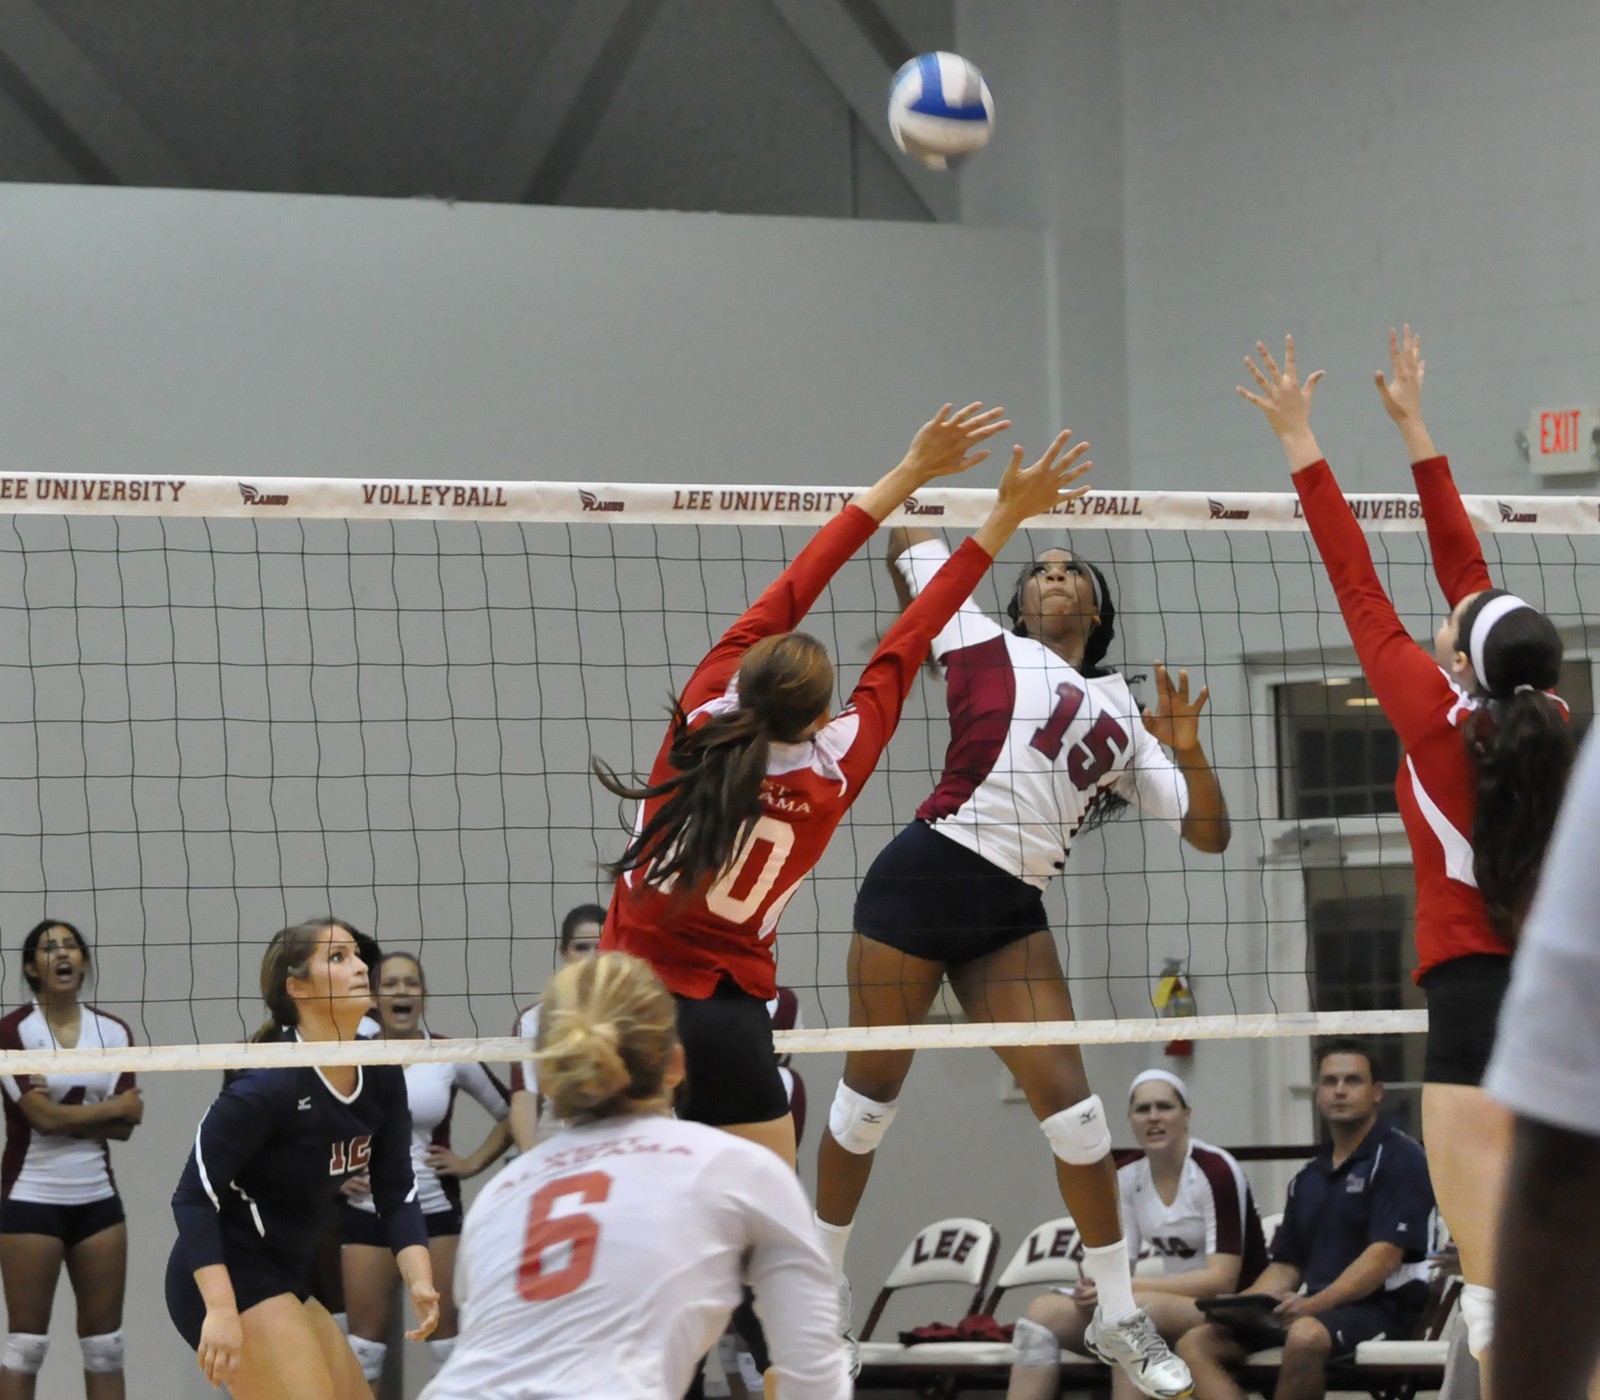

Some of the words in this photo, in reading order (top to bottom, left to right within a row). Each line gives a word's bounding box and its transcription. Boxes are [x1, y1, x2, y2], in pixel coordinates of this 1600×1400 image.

[1540, 410, 1581, 455] EXIT
[0, 478, 28, 499] EE
[36, 478, 186, 501] UNIVERSITY
[361, 484, 508, 507] VOLLEYBALL
[672, 490, 713, 510] LEE
[720, 491, 854, 512] UNIVERSITY
[1043, 496, 1143, 515] LEYBALL
[1348, 501, 1425, 519] NIVERS
[1029, 681, 1129, 791] 15
[515, 1169, 614, 1303] 6
[911, 1228, 979, 1267] LEE
